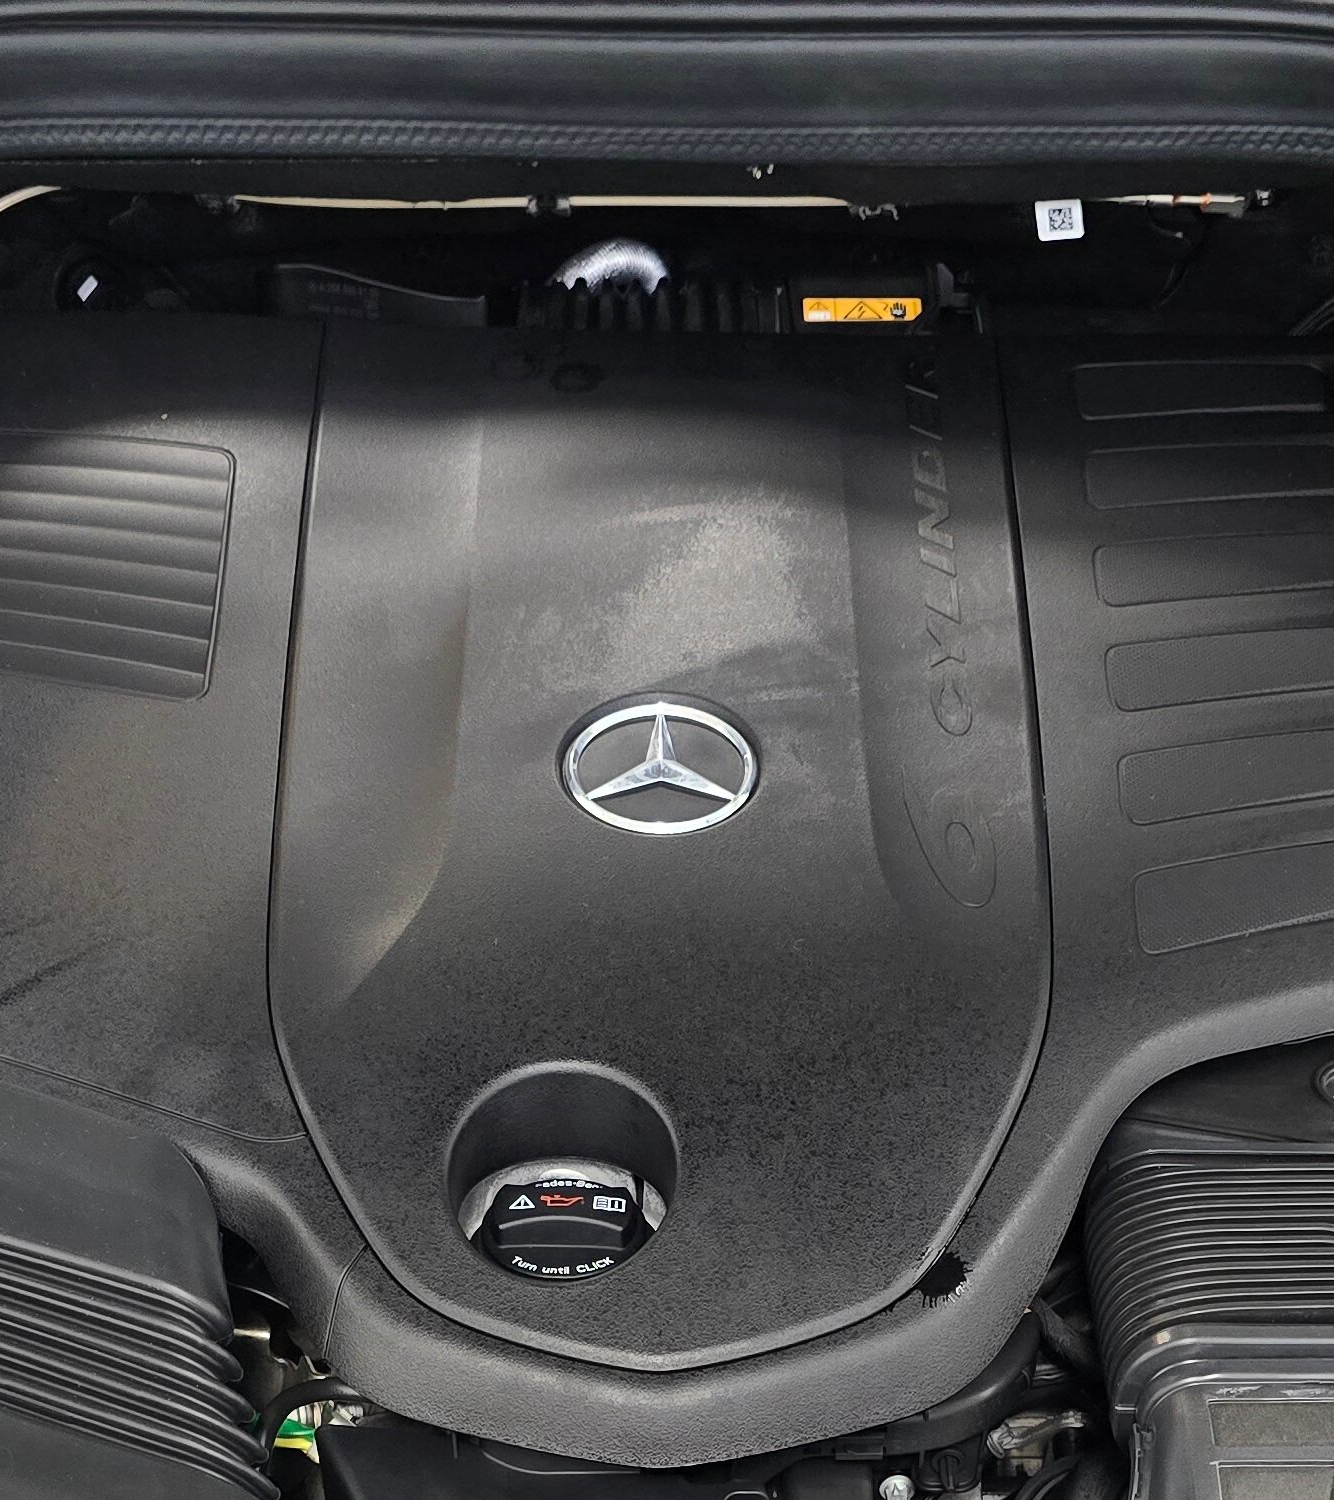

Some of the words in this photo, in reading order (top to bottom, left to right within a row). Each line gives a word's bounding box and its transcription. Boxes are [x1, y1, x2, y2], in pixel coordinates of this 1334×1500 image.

[511, 1256, 538, 1272] Turn
[542, 1266, 570, 1275] until
[575, 1257, 615, 1274] CLICK
